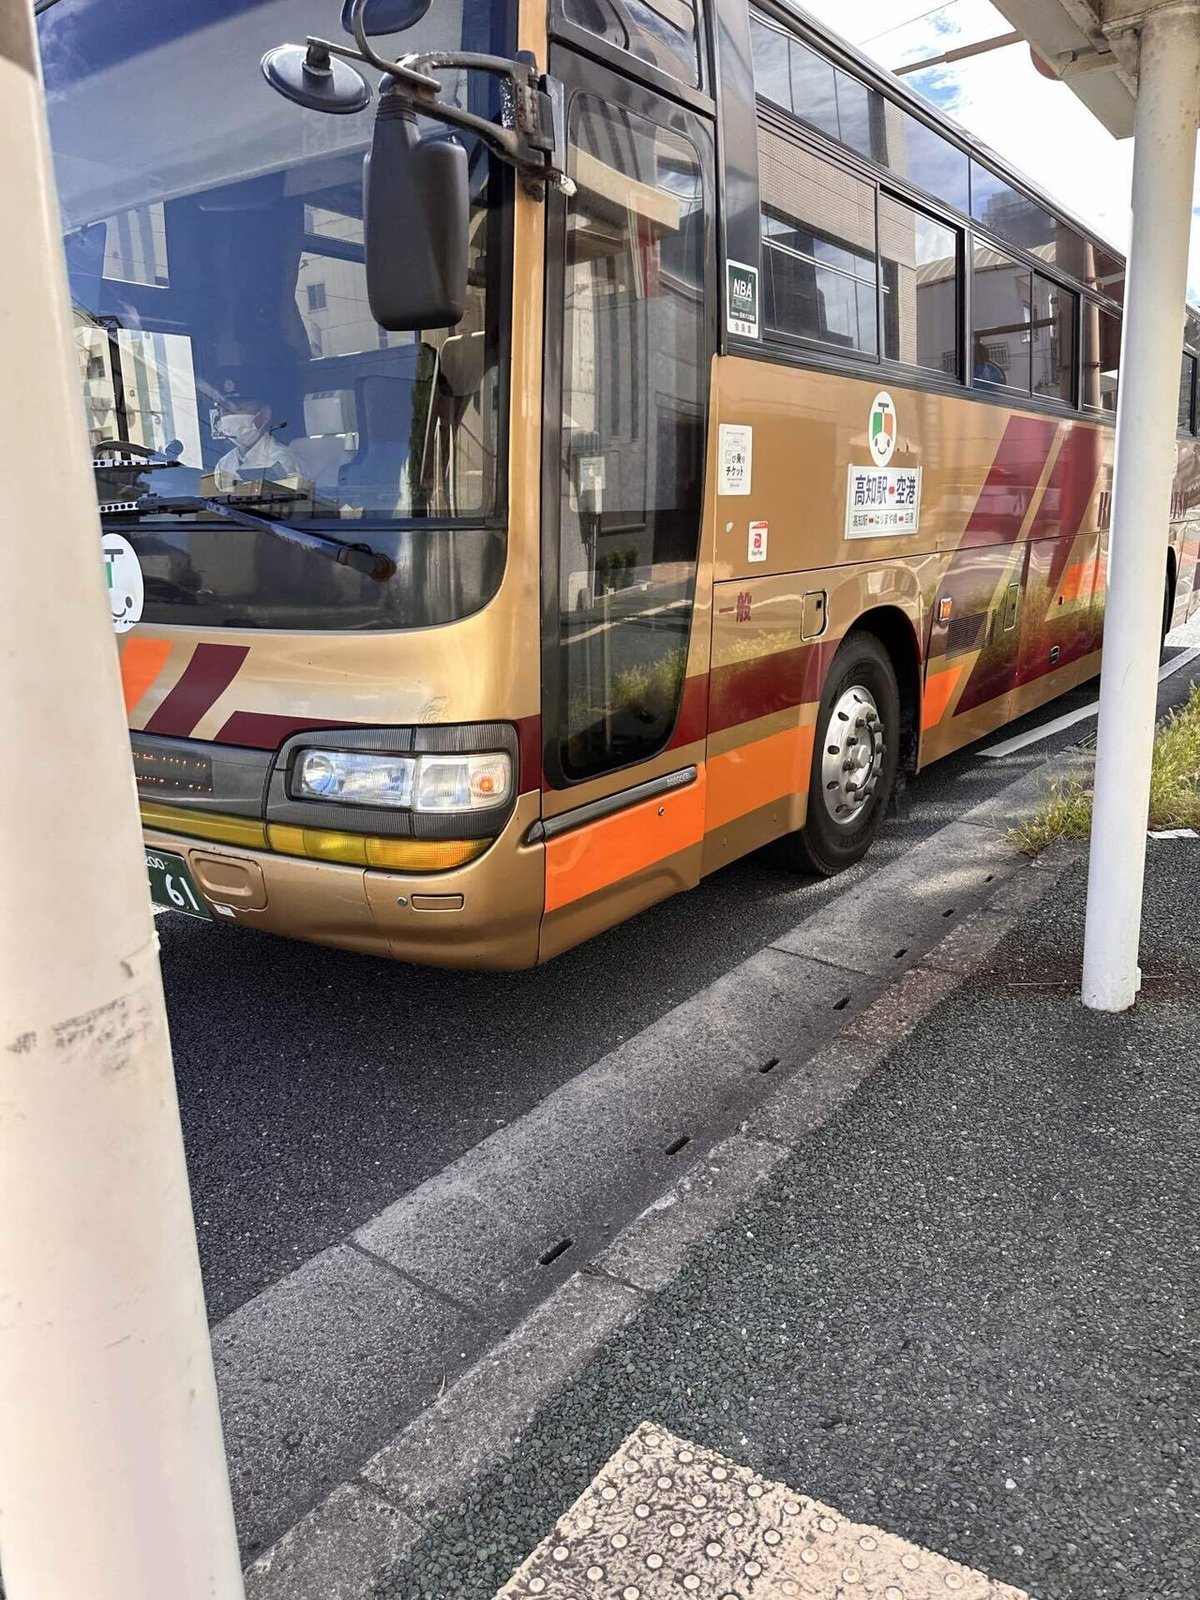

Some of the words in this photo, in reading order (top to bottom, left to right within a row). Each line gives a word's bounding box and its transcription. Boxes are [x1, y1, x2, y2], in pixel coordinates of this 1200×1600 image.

[733, 278, 752, 299] NBA
[726, 465, 743, 476] チケット
[855, 474, 888, 506] 高知駅
[896, 475, 916, 505] 空港
[853, 513, 868, 527] 高知駅
[719, 592, 752, 623] 一般
[667, 773, 691, 787] HINO
[166, 873, 200, 911] 61
